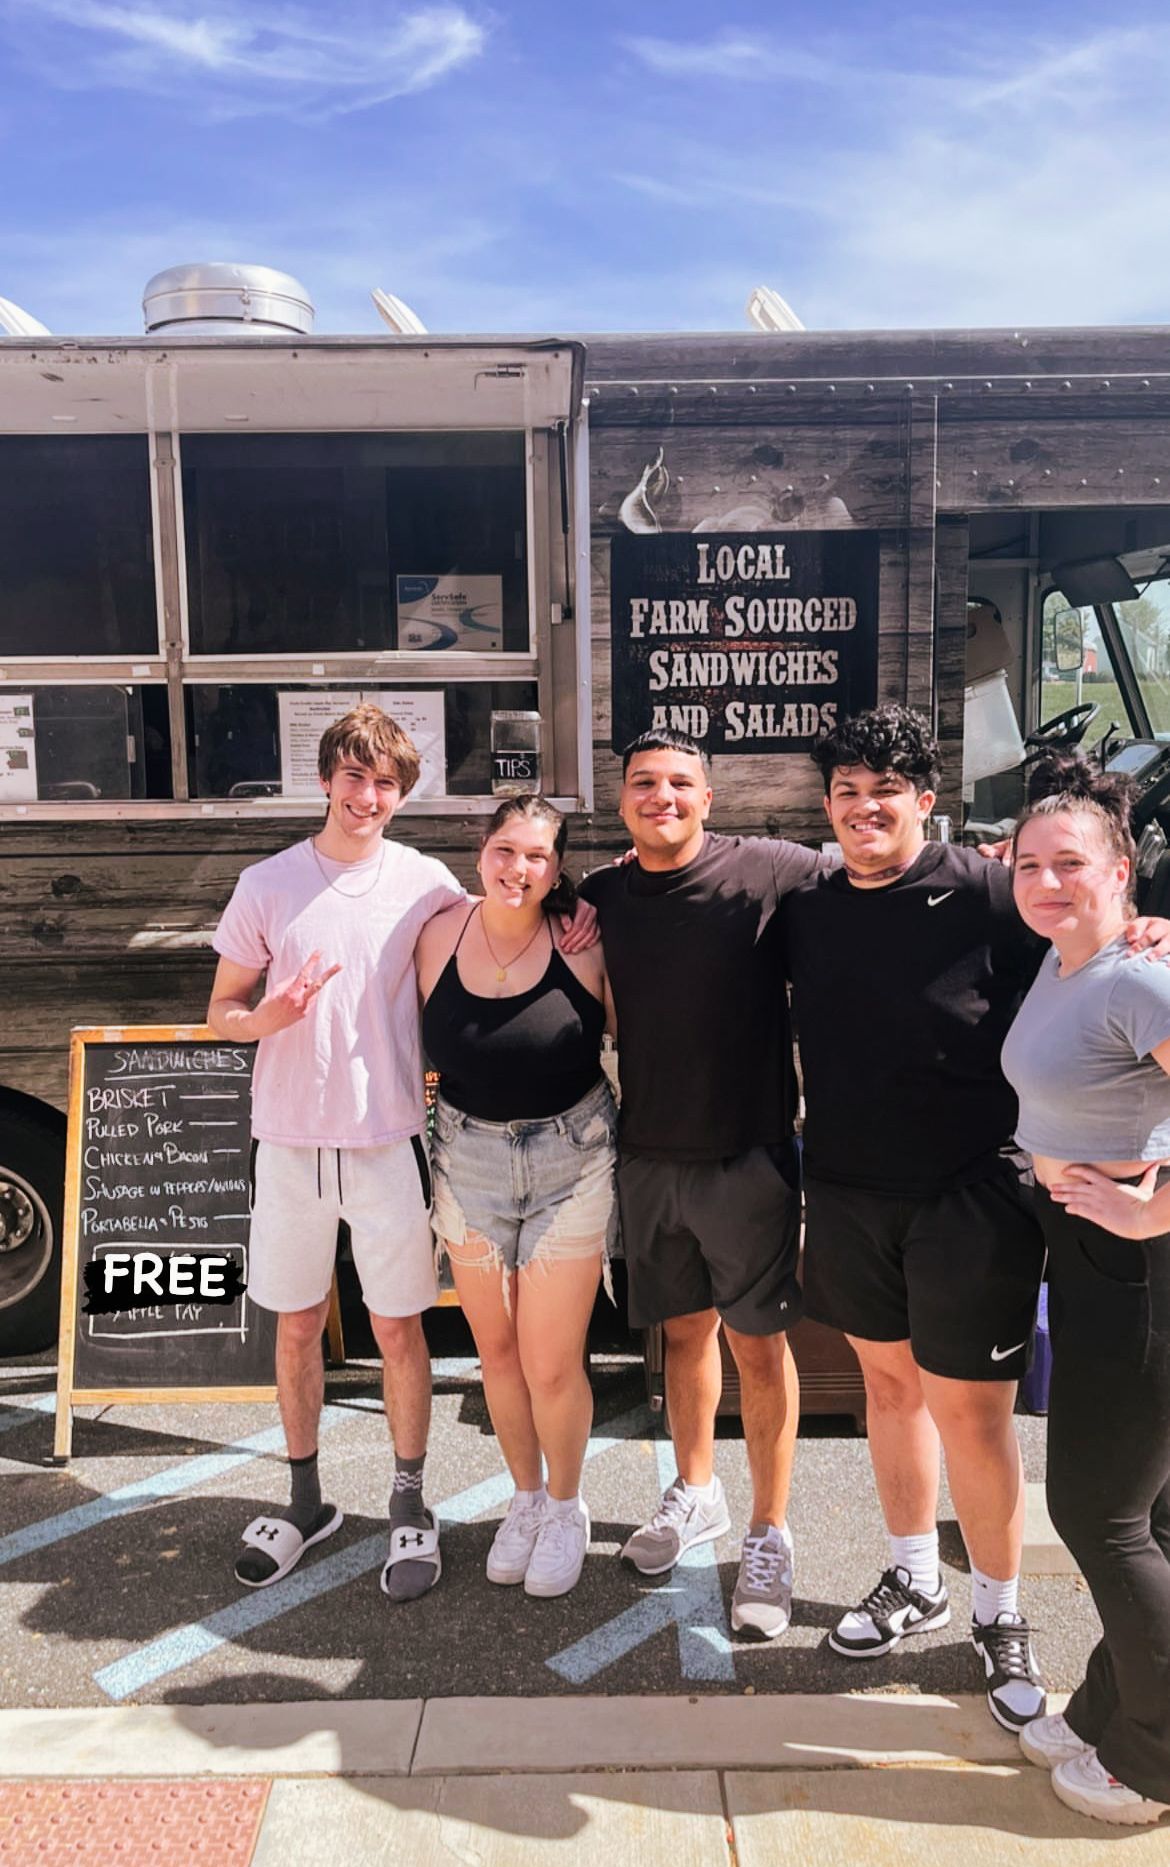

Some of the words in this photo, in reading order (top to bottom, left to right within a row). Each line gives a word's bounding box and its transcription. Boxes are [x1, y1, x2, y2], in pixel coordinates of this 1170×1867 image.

[697, 543, 791, 584] LOCAL
[630, 598, 710, 638] FARM
[724, 595, 857, 637] SOURCED
[649, 650, 839, 691] SANDWICHES
[652, 705, 709, 738] AND
[725, 701, 838, 741] SALADS
[495, 759, 531, 777] TIPS
[107, 1049, 248, 1072] SANDWICHES
[87, 1085, 176, 1112] BRISKET
[86, 1117, 139, 1140] PULLED
[144, 1113, 184, 1138] PORK
[84, 1176, 145, 1200] SAUSAGE
